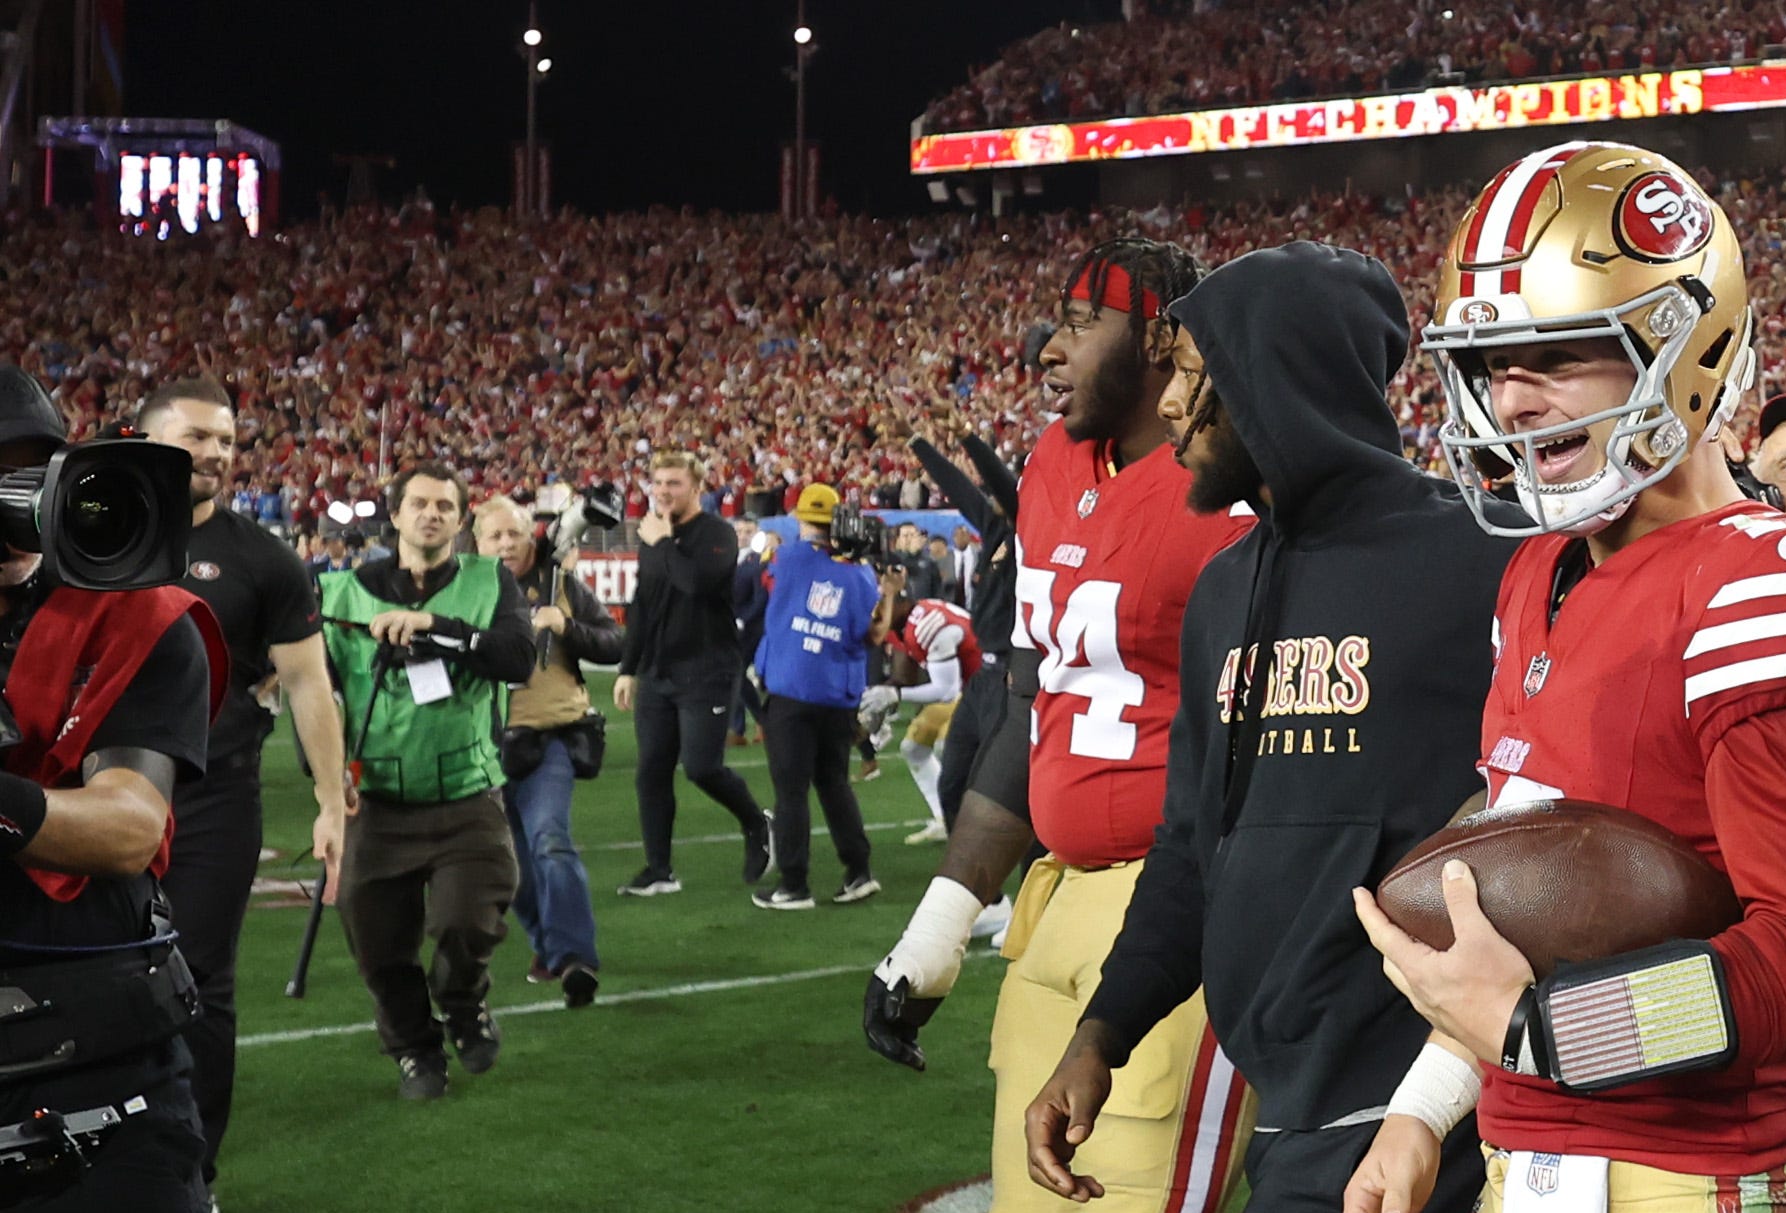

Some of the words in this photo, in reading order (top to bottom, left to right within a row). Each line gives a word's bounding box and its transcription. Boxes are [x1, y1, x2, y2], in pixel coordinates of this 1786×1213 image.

[1188, 103, 1297, 150] NFC
[1325, 69, 1705, 137] CHAMPIONS
[1530, 1165, 1556, 1192] NFL
